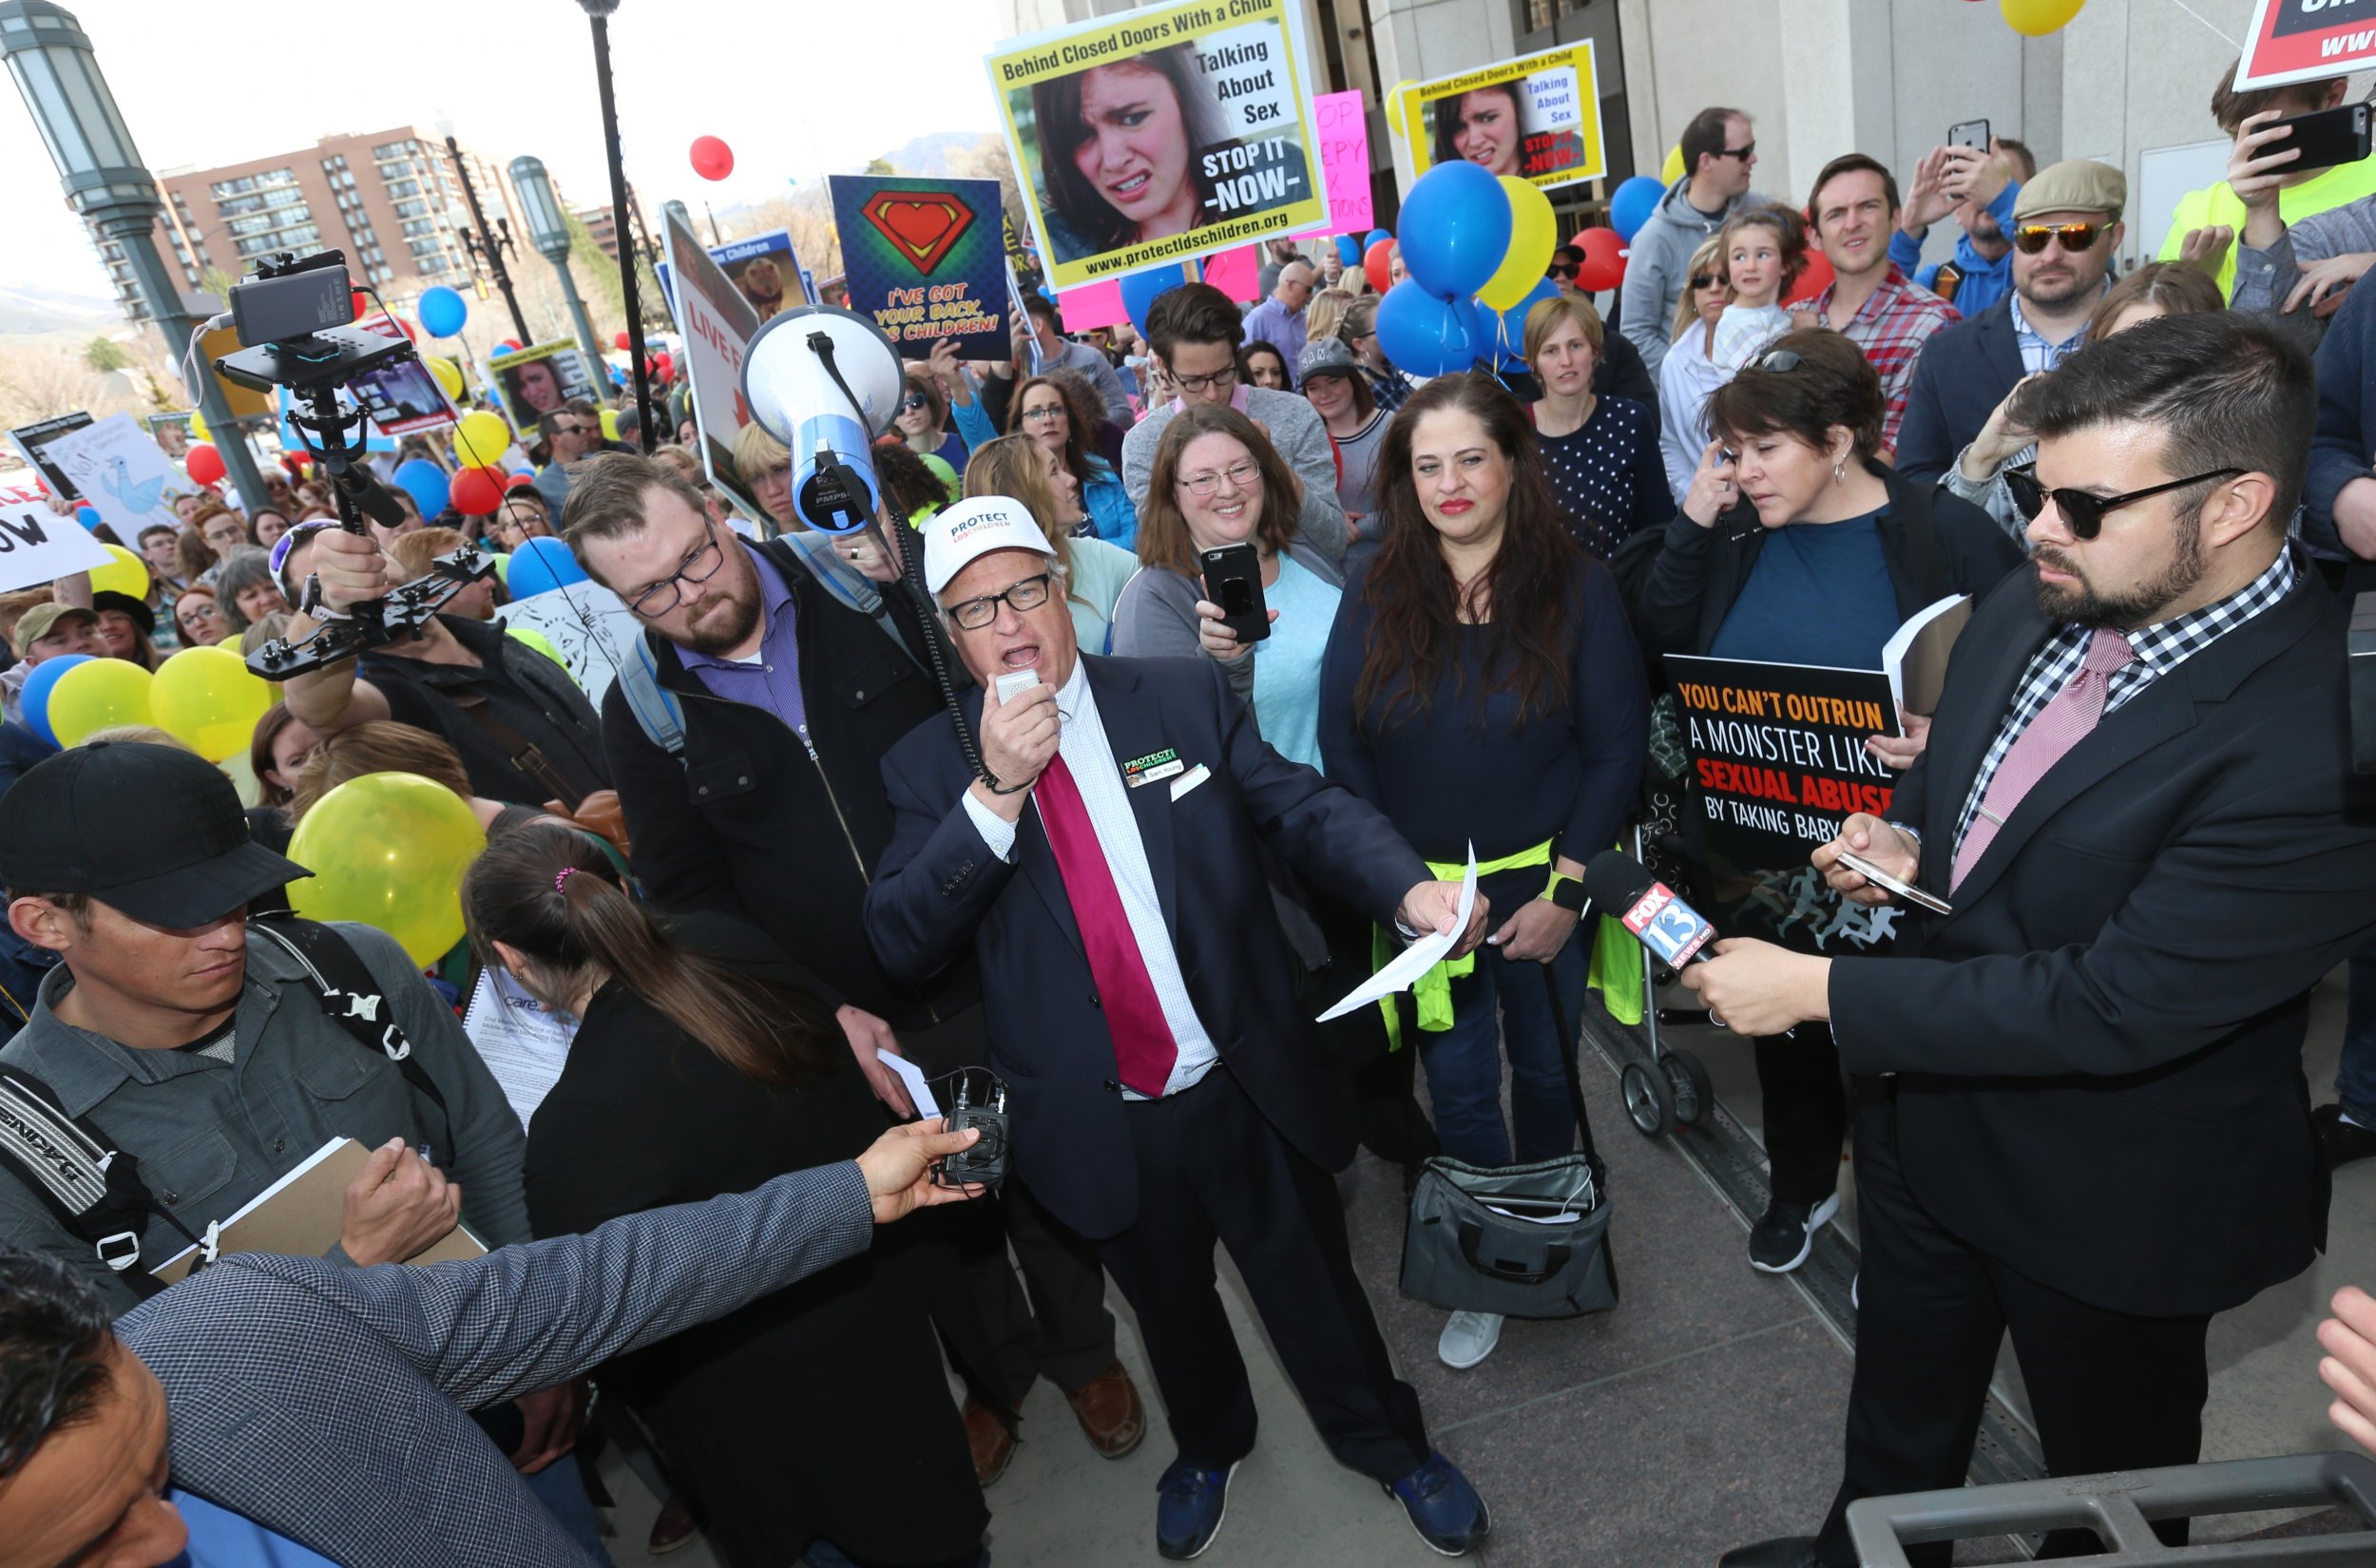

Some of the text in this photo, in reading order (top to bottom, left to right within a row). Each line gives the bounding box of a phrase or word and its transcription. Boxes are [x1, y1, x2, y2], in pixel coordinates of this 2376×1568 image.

[1003, 49, 1060, 81] Behind
[1062, 33, 1119, 64] Closed
[1121, 23, 1170, 48] Doors
[1173, 9, 1212, 32] With
[1216, 7, 1226, 22] a
[1195, 41, 1269, 75] Talking
[2321, 29, 2376, 58] ww
[1217, 68, 1274, 102] About
[1420, 80, 1452, 97] Behind
[1453, 72, 1485, 89] Closed
[1486, 65, 1515, 81] Doors
[1516, 60, 1539, 73] With
[1548, 49, 1573, 65] Child
[1527, 77, 1568, 96] Talking
[1244, 102, 1280, 124] Sex
[1538, 92, 1569, 110] About
[1551, 110, 1572, 124] Sex
[1202, 135, 1285, 178] STOP IT
[1524, 128, 1574, 153] STOP IT
[1204, 165, 1301, 213] -NOW-
[726, 241, 771, 262] Children
[1085, 213, 1288, 276] www.protectldschildren.org
[888, 282, 968, 308] I'VE GOT
[873, 299, 985, 327] YOUR BACK,
[903, 314, 1000, 341] CHILDREN!
[688, 299, 731, 365] LIVE
[815, 492, 853, 505] PMP5
[951, 513, 1007, 537] PROTECT
[1677, 683, 1885, 731] YOU CAN'T OUTRUN
[1124, 749, 1171, 770] PROTECT
[1690, 717, 1705, 750] A
[1707, 718, 1824, 768] MONSTER
[1696, 757, 1798, 804] SEXUAL
[1705, 796, 1841, 844] BY TAKING BABY
[1628, 888, 1670, 929] FOX
[1646, 905, 1697, 959] 13
[1673, 927, 1711, 967] NEWS HD
